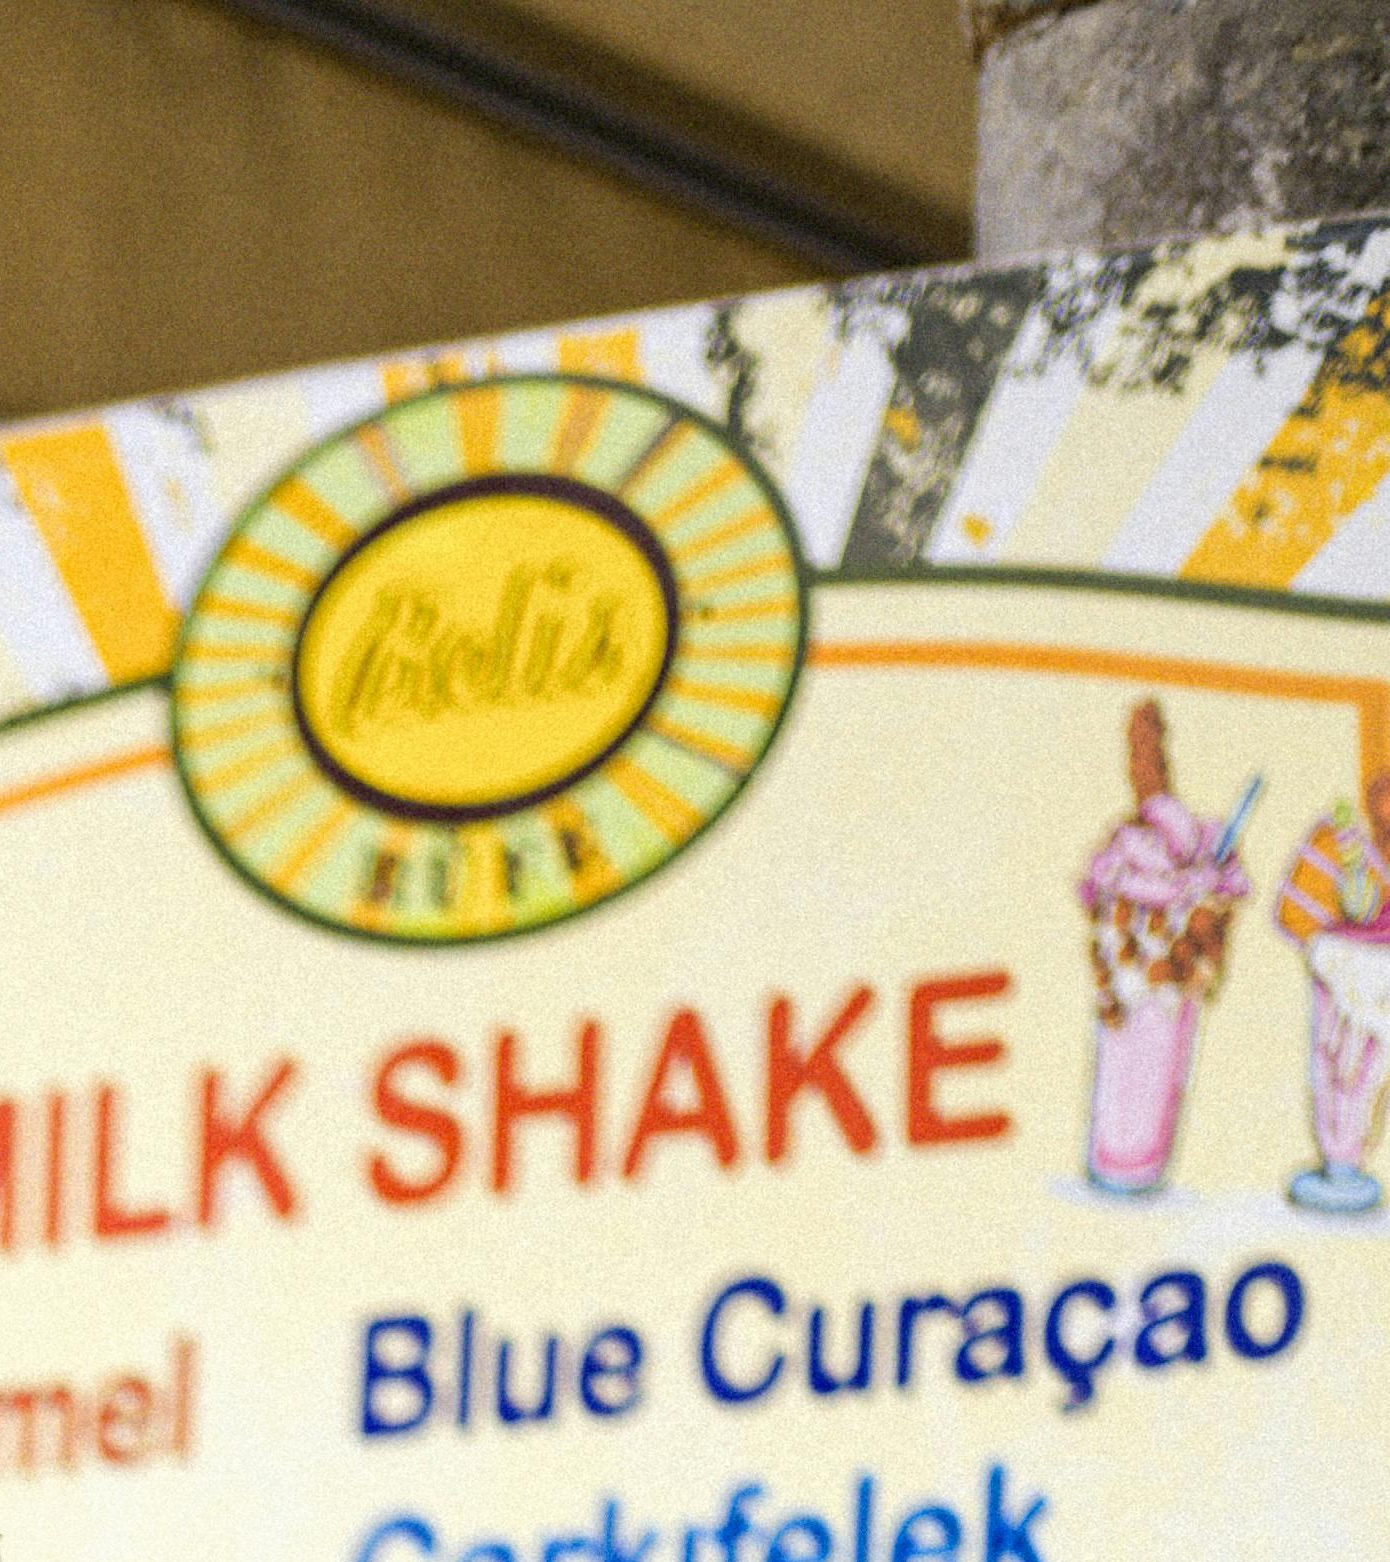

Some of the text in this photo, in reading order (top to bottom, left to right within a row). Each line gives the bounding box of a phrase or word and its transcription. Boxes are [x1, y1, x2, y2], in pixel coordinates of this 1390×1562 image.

[365, 968, 1015, 1209] SHAKE
[357, 1258, 1308, 1441] Blue Curaçao
